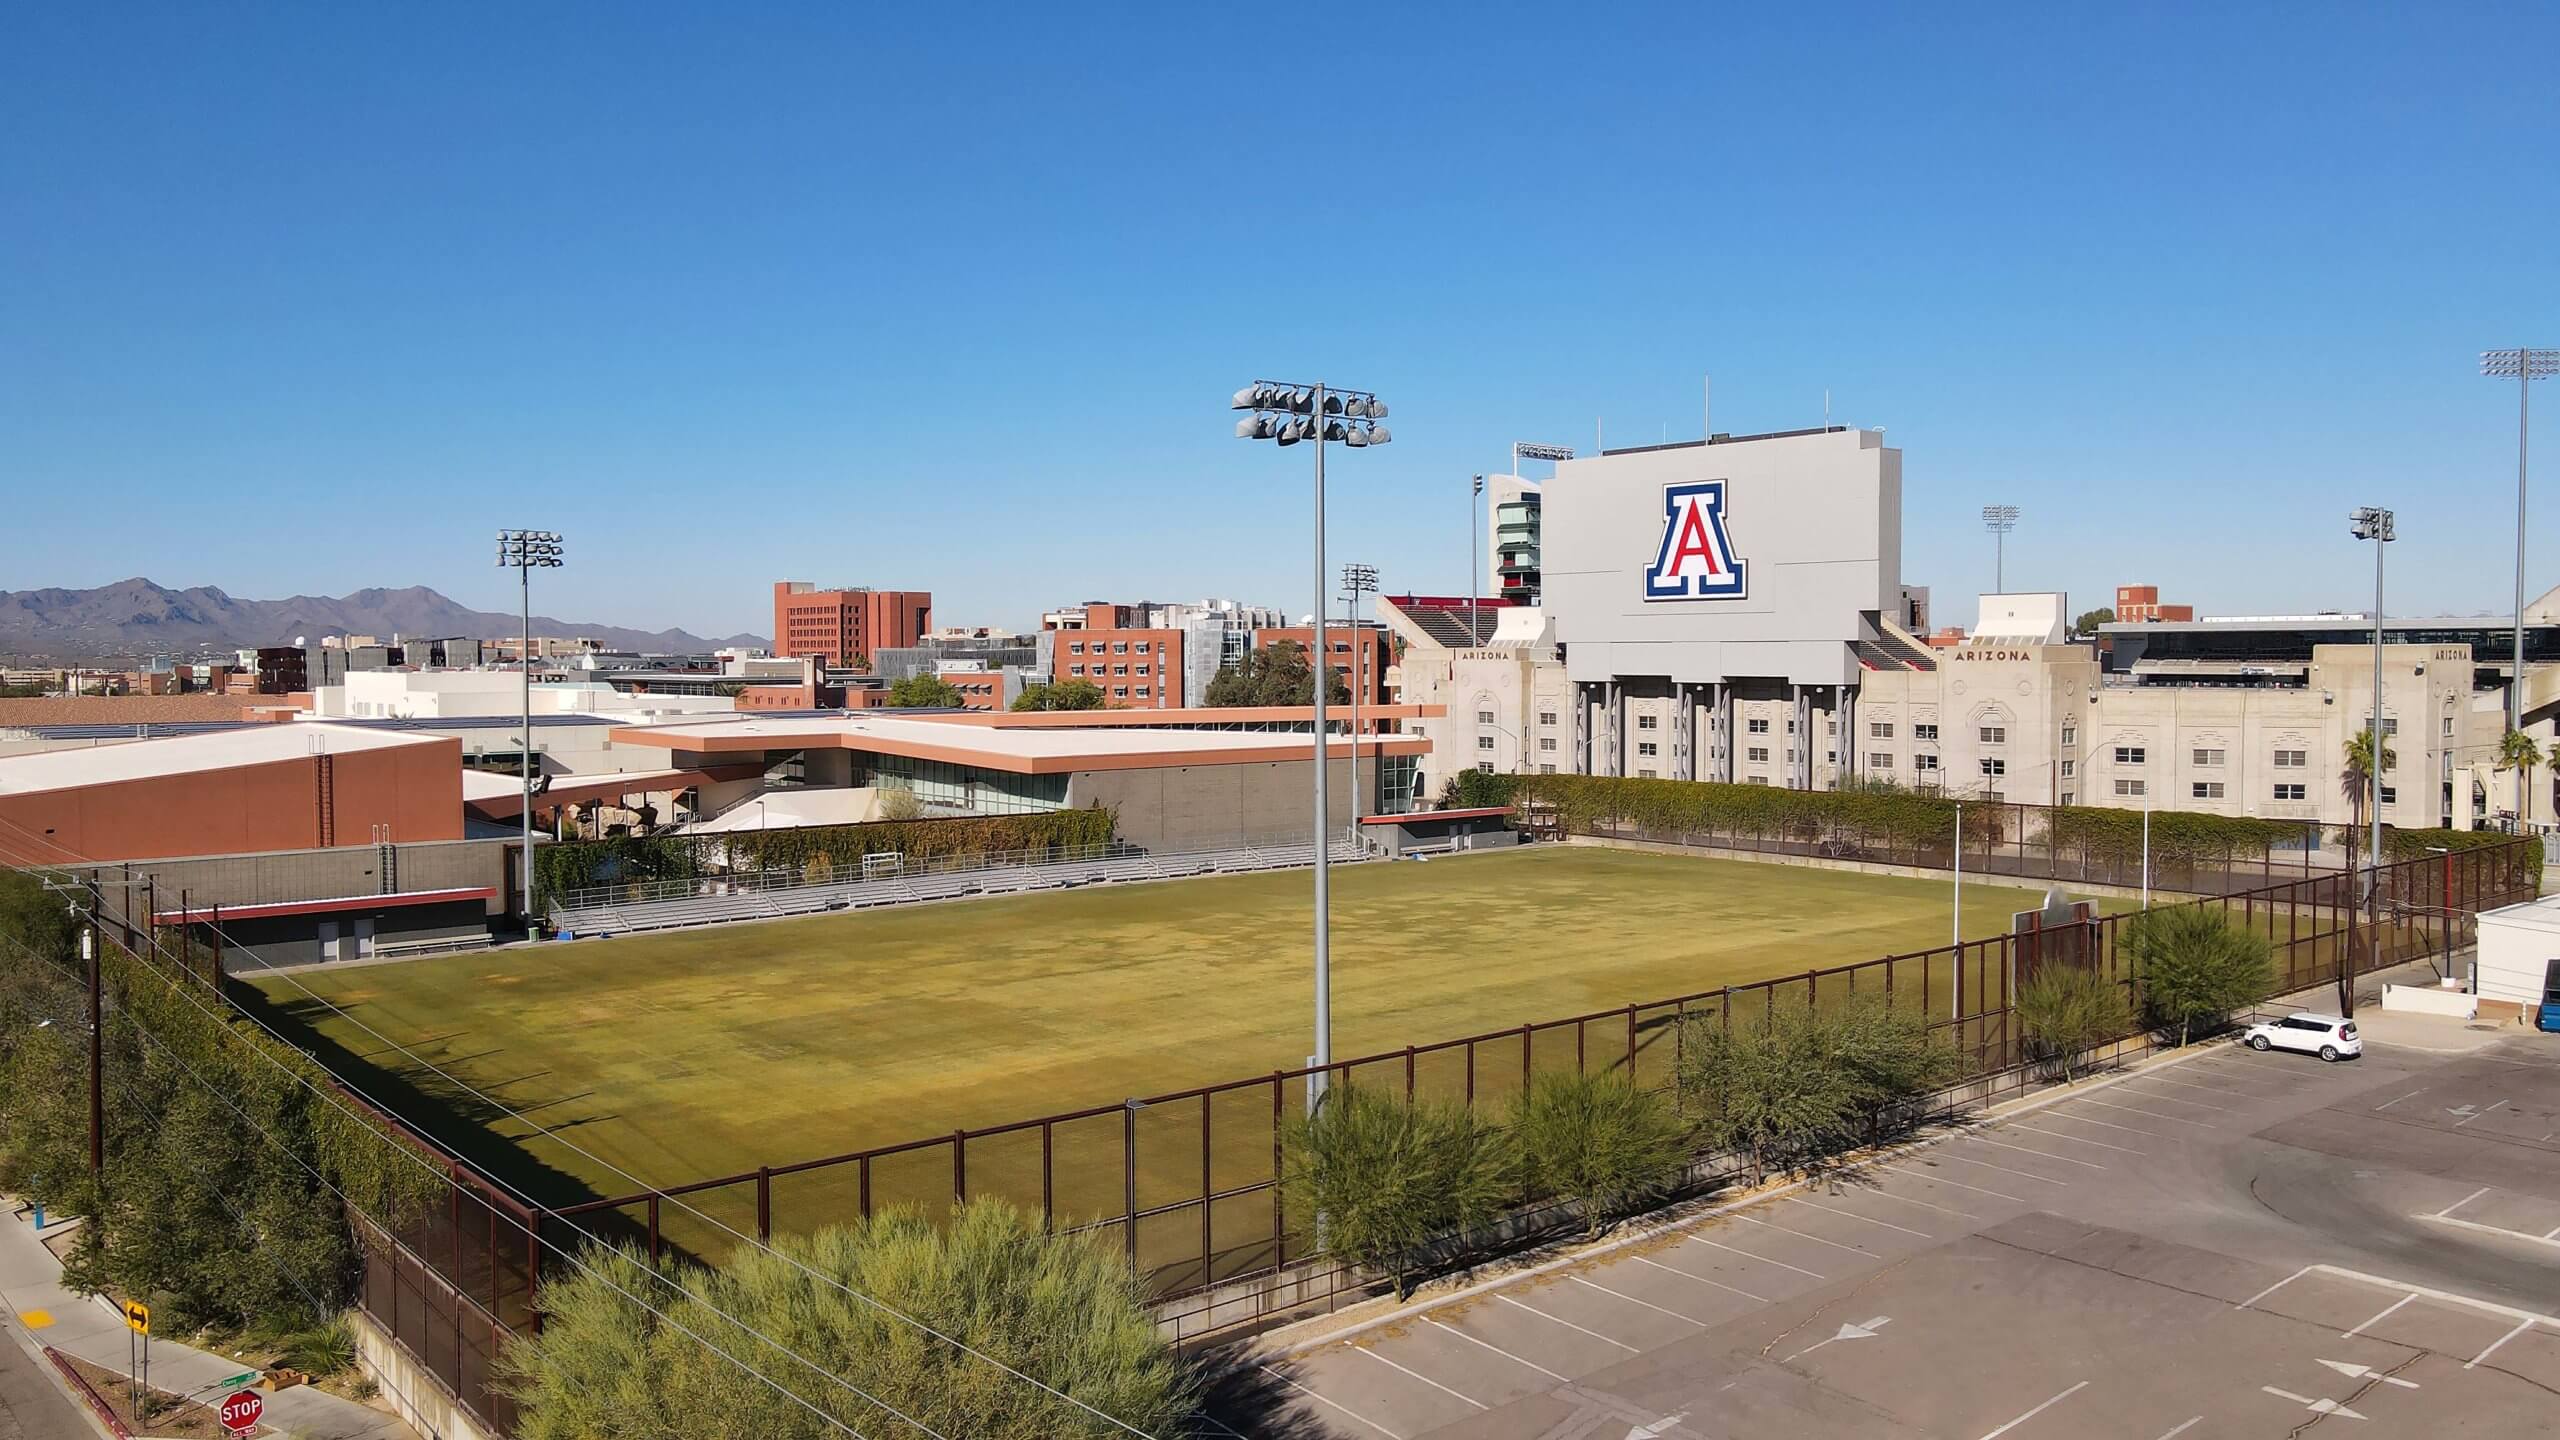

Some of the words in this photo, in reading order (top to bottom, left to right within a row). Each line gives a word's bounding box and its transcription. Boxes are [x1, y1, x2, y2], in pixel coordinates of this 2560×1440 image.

[1644, 479, 1748, 602] A
[1462, 651, 1509, 660] ARIZONA
[1955, 651, 2031, 661] ARIZONA
[2435, 649, 2468, 660] ARIZONA
[223, 1399, 261, 1421] STOP
